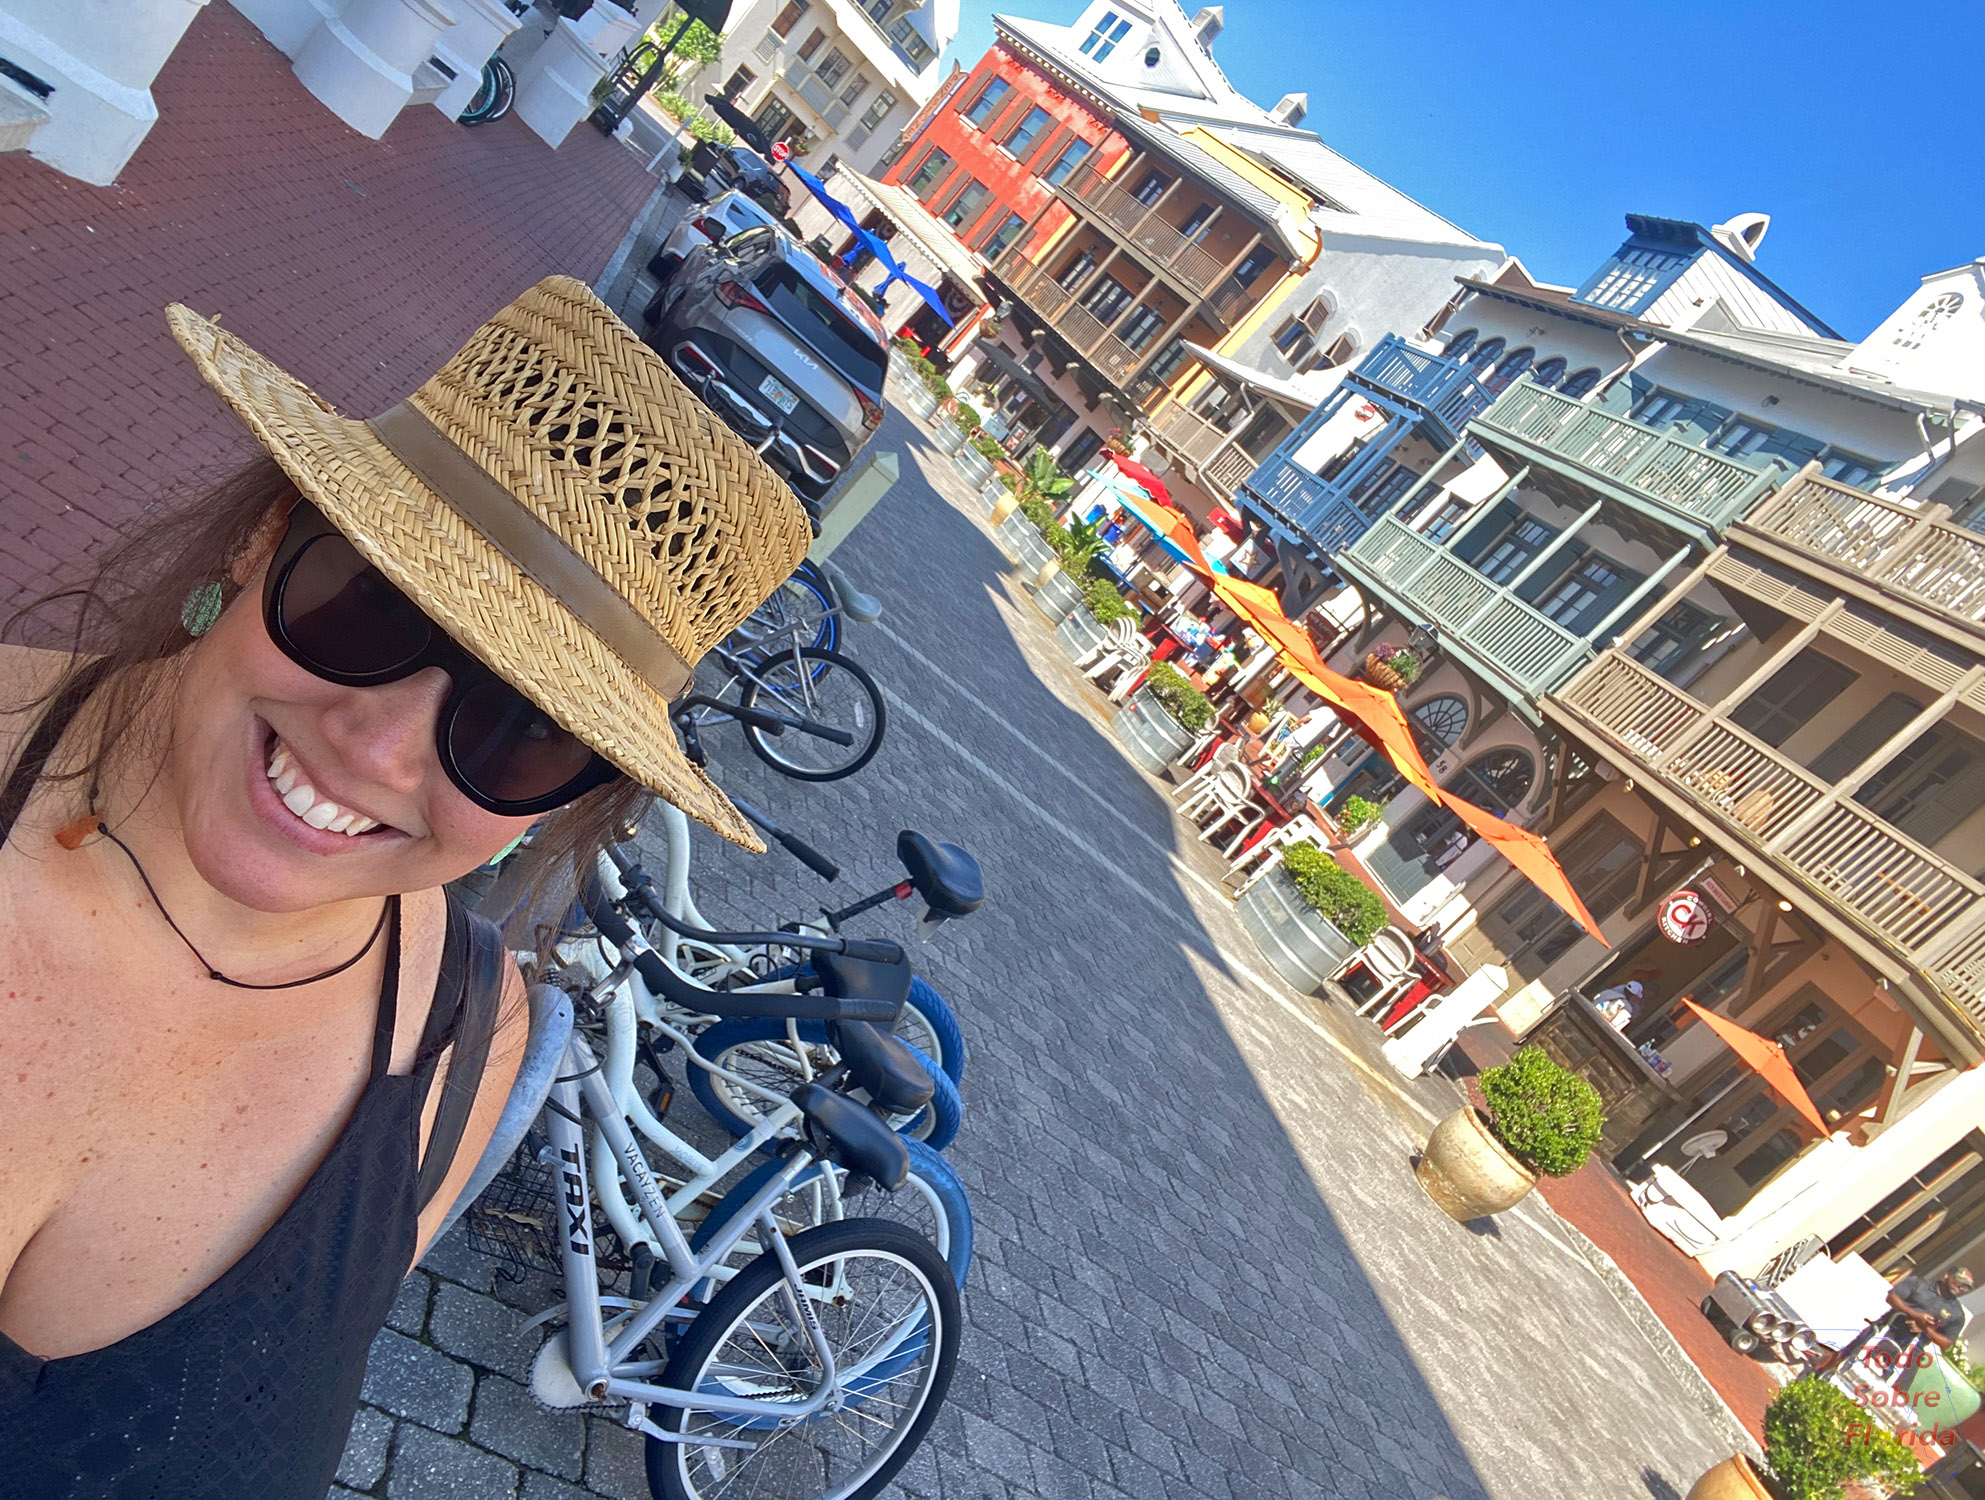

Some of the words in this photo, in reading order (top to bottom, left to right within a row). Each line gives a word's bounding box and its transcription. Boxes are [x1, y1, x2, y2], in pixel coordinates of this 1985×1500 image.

[773, 144, 788, 157] STOP
[1436, 760, 1447, 774] 58
[1687, 895, 1713, 925] COWGIRL
[1662, 916, 1689, 944] KITCHEN
[624, 1142, 665, 1218] VACAYZEN
[560, 1143, 589, 1255] TAXI
[794, 1283, 819, 1330] JAMIS
